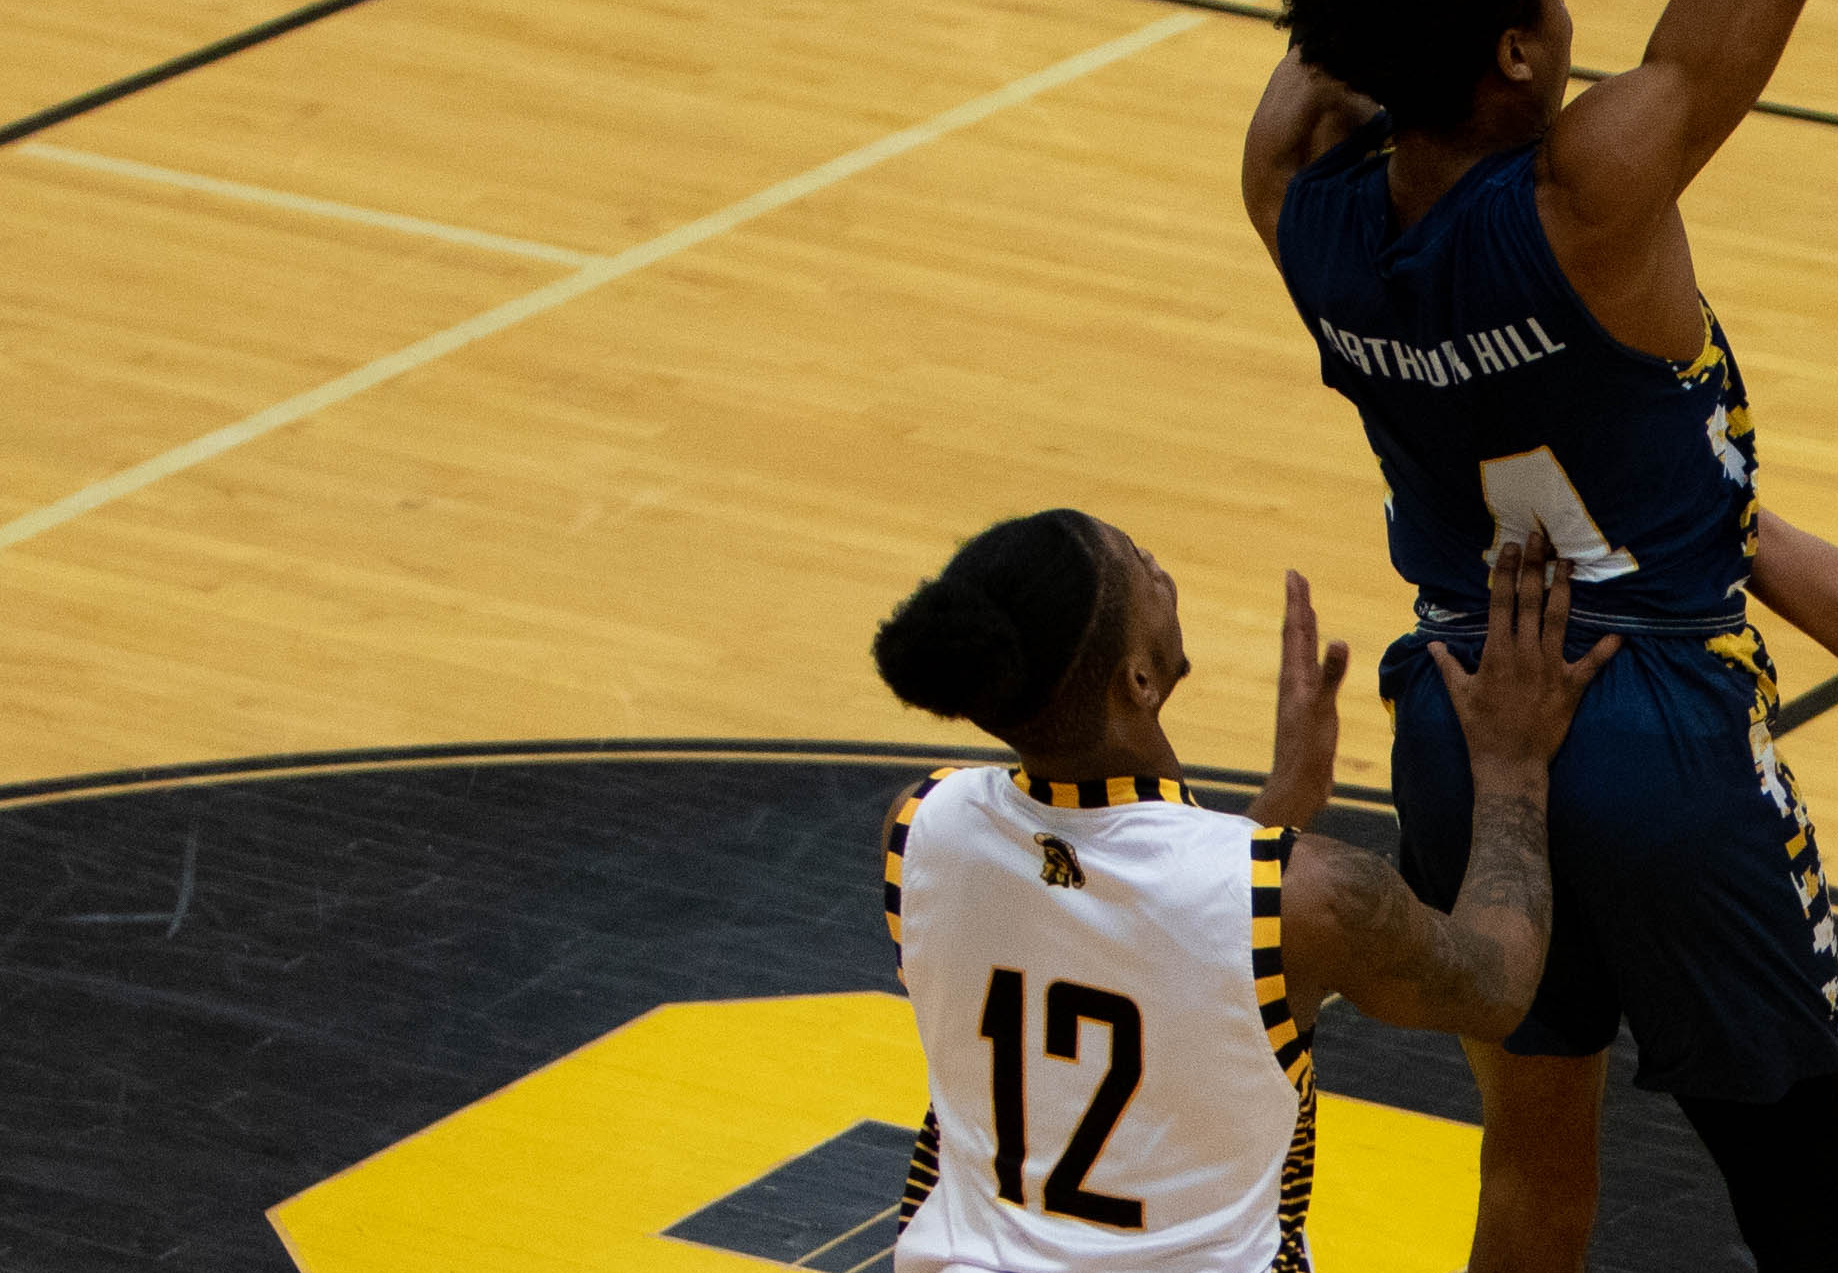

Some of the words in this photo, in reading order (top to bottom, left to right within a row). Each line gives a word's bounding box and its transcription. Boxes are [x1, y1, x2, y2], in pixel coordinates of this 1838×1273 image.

[1318, 316, 1473, 388] ARTHUR
[1466, 317, 1566, 374] HILL
[980, 967, 1146, 1230] 12
